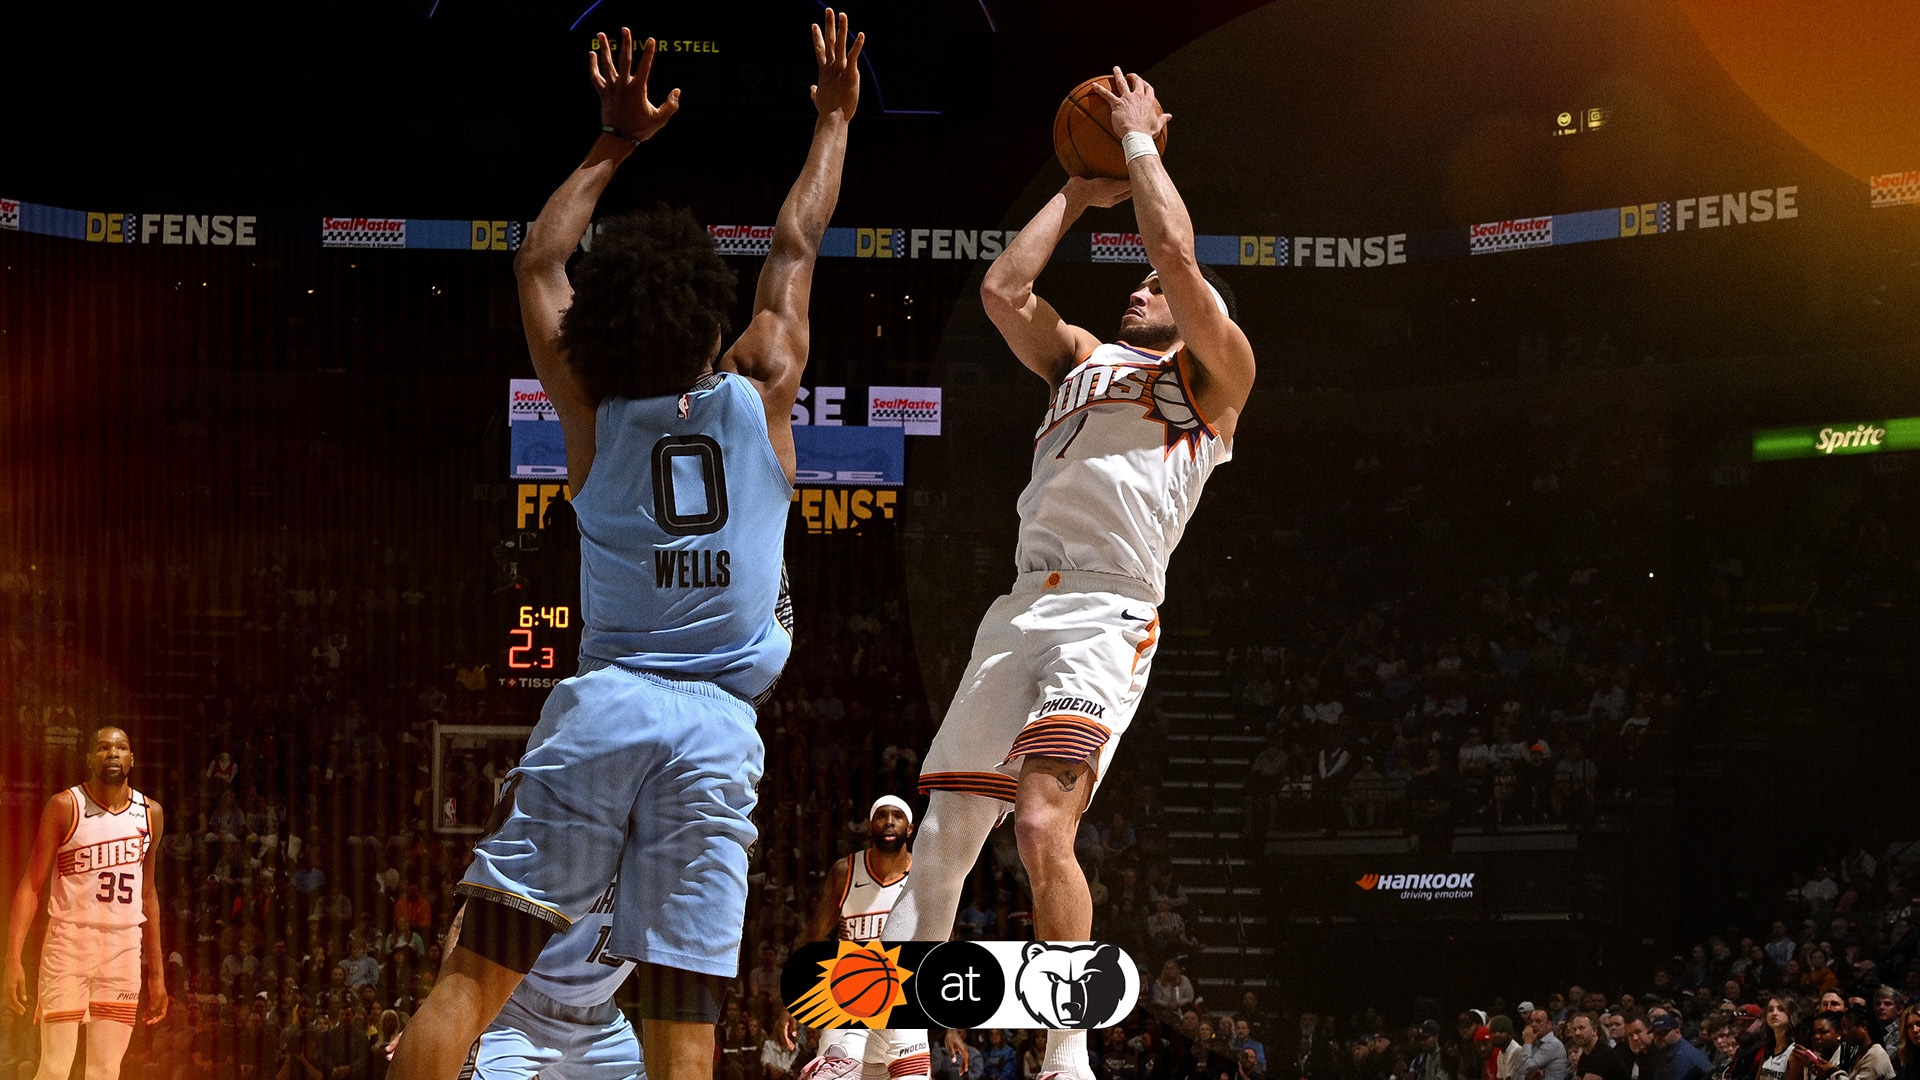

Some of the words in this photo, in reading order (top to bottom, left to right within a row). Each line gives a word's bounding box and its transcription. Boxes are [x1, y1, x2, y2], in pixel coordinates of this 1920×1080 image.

[591, 38, 617, 51] BG
[673, 40, 720, 53] STEEL
[86, 210, 124, 243] DE
[141, 212, 257, 245] FENSE
[1472, 218, 1550, 235] SealMaster
[1619, 202, 1658, 238] DE
[1676, 186, 1798, 231] FENSE
[323, 217, 403, 232] SealMaster
[471, 220, 509, 251] DE
[709, 225, 775, 239] SealMast
[856, 228, 894, 258] DE
[1239, 236, 1277, 266] DE
[1294, 233, 1407, 267] FENSE
[514, 391, 549, 402] SealM
[872, 398, 937, 409] SealMaster
[1815, 424, 1885, 454] Sprite
[651, 434, 729, 537] 0
[654, 549, 731, 589] WELLS
[519, 605, 569, 628] 6:40
[509, 629, 555, 669] 2.3
[519, 678, 562, 688] TISSO
[1037, 697, 1106, 720] PHOENIX
[96, 872, 135, 904] 35
[1400, 890, 1432, 901] driving
[1434, 889, 1473, 899] emotion
[846, 913, 890, 940] SUN
